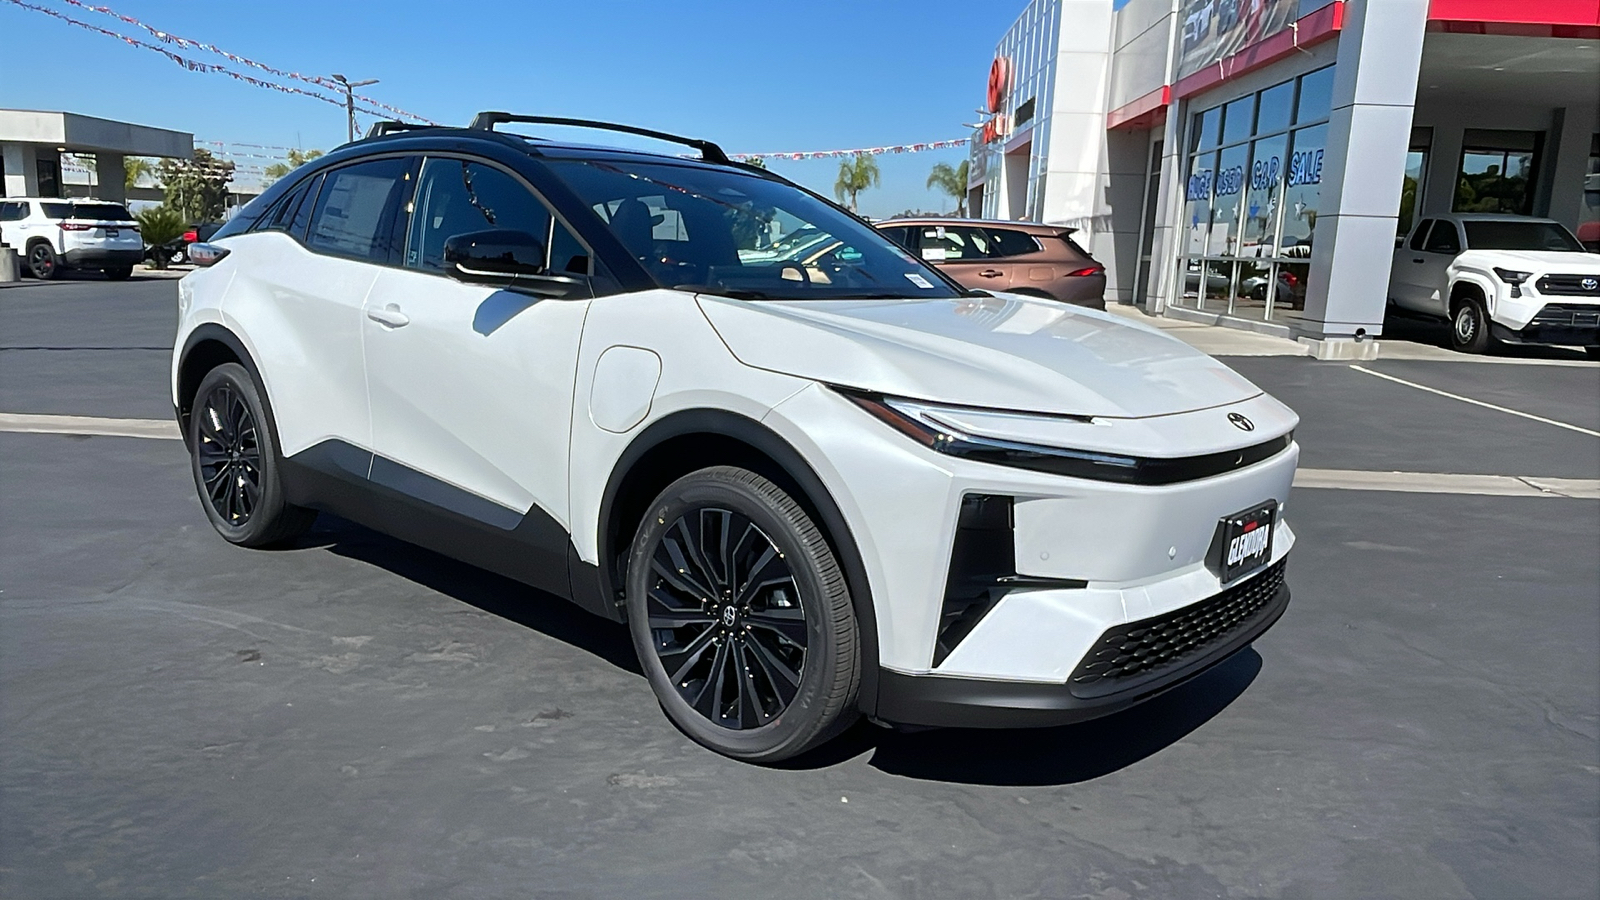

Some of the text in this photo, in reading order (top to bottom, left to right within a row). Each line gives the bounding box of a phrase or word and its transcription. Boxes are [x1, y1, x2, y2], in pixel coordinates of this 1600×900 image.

[1216, 165, 1244, 197] USED
[1251, 156, 1280, 190] CAR
[1288, 149, 1324, 187] SALE
